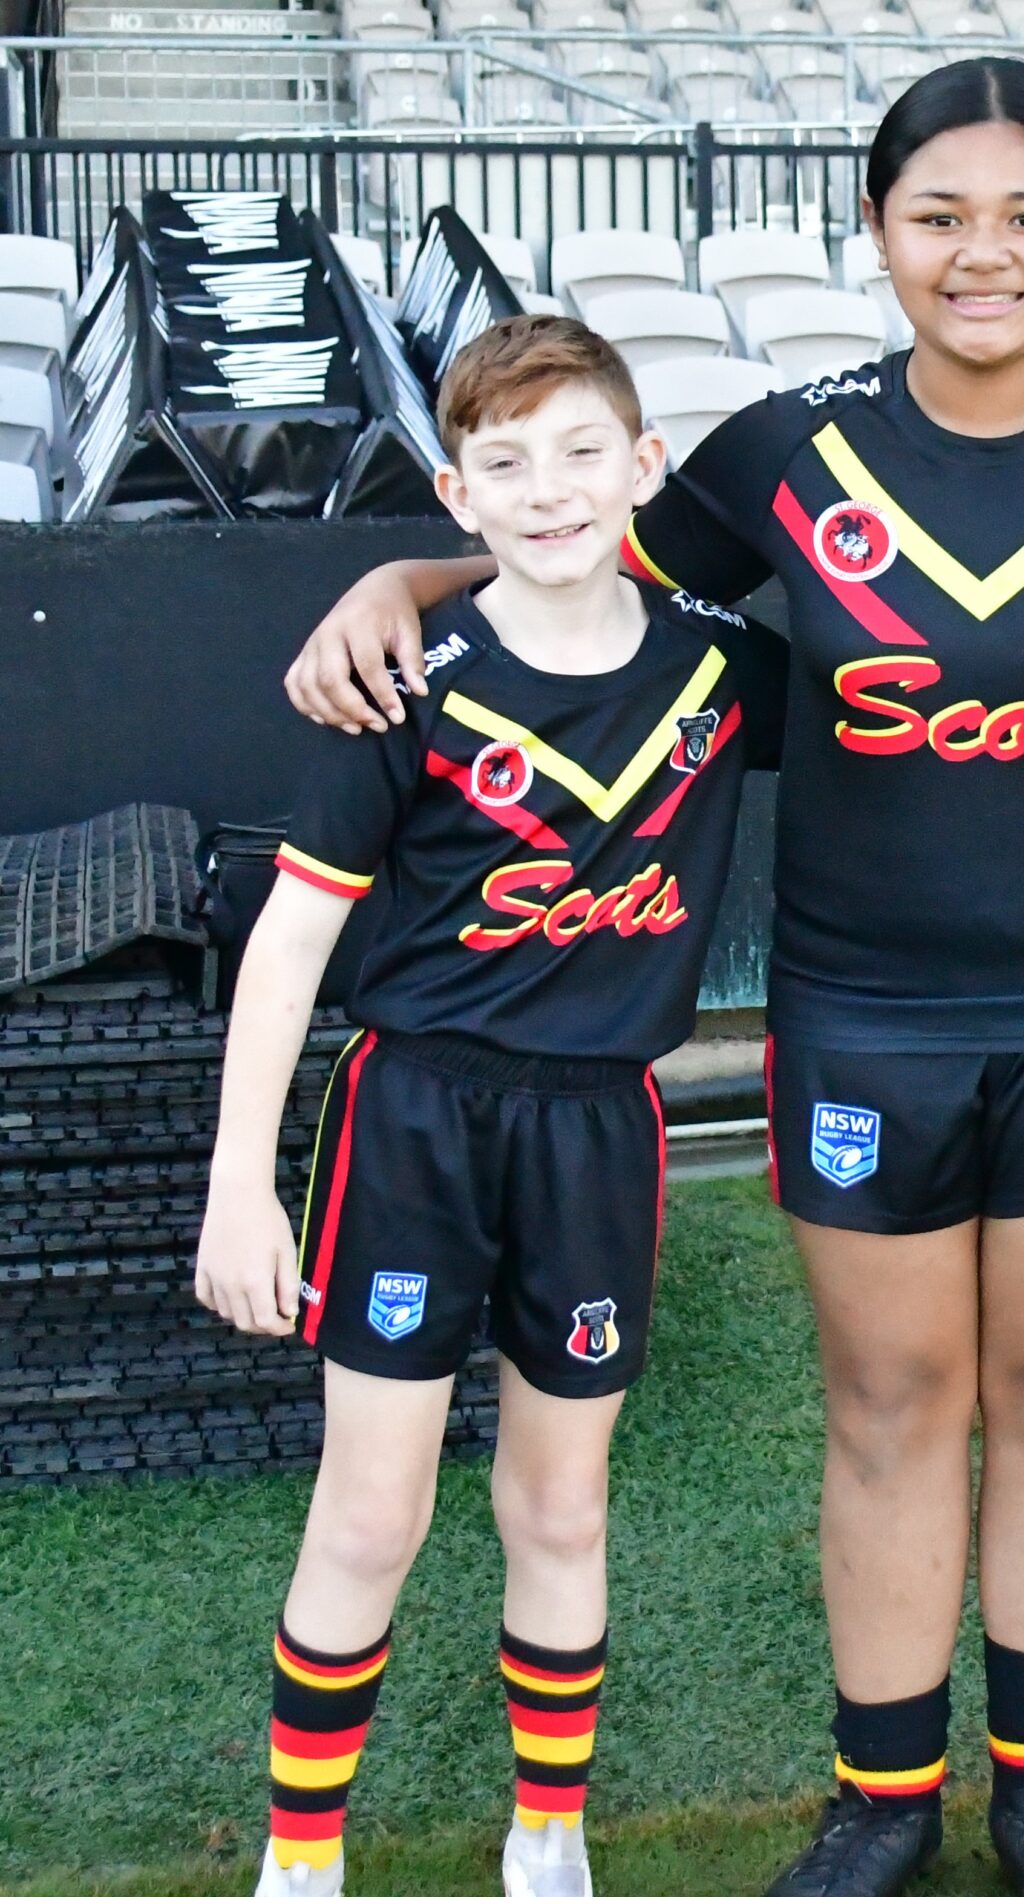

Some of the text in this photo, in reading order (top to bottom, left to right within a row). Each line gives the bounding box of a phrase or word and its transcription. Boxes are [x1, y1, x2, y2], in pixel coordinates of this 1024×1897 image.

[110, 13, 287, 34] NO STANDING
[424, 632, 470, 676] SM
[458, 859, 689, 951] Scots
[820, 1109, 874, 1135] NSW
[844, 1133, 872, 1144] LEAGUE
[378, 1277, 423, 1295] NSW
